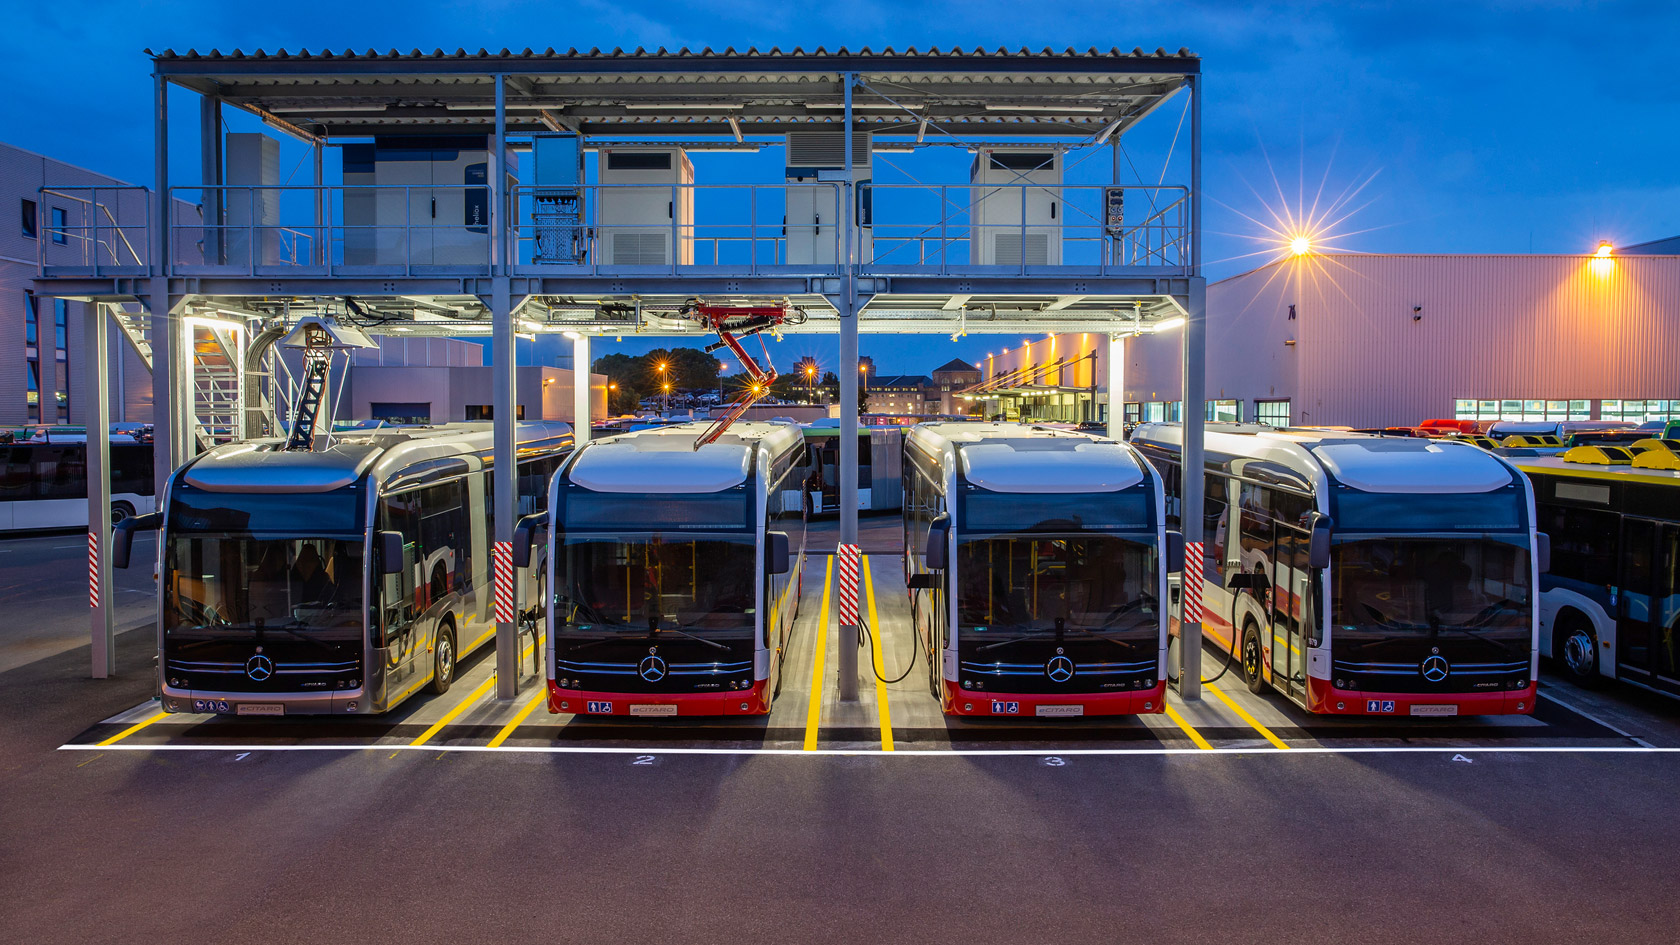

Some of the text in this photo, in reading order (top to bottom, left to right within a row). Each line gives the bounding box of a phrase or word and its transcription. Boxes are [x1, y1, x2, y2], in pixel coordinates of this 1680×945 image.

[1288, 304, 1297, 321] 76
[235, 751, 252, 761] 1
[632, 755, 656, 765] 2
[1044, 756, 1066, 767] 3
[1451, 753, 1474, 764] 4
